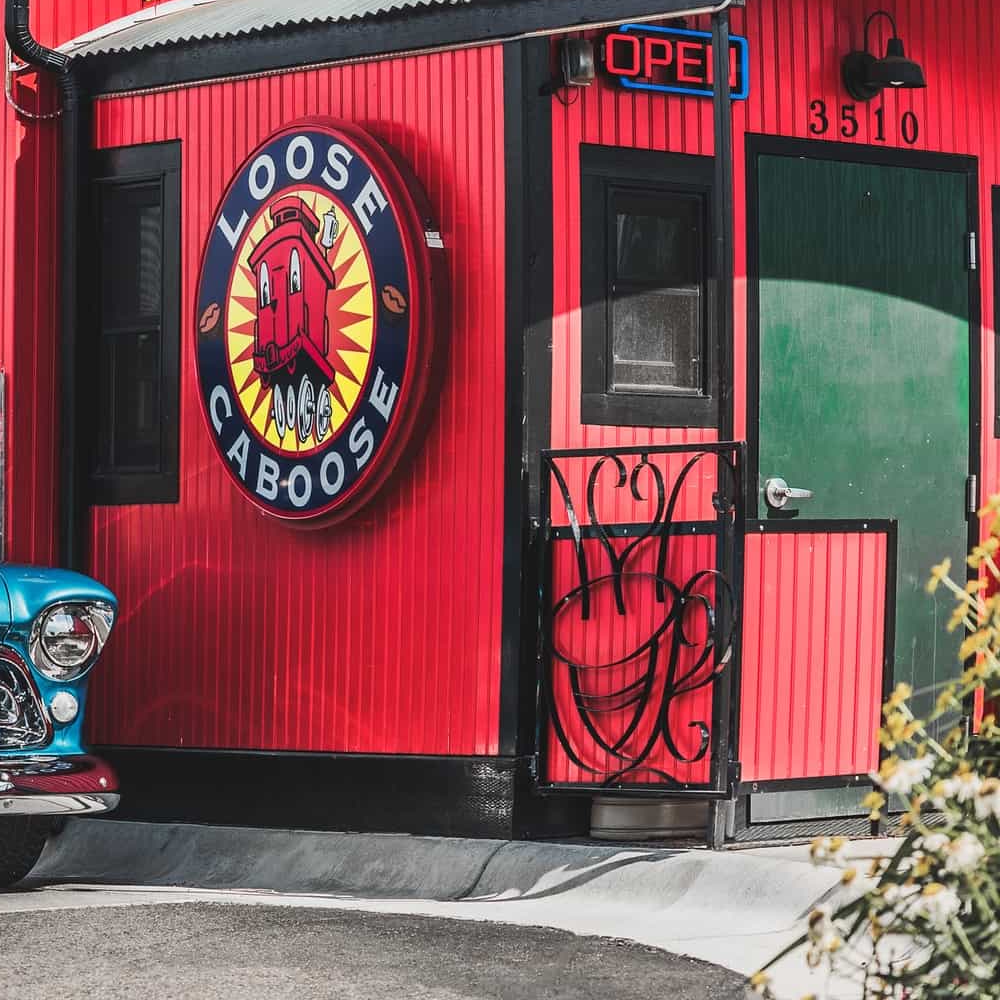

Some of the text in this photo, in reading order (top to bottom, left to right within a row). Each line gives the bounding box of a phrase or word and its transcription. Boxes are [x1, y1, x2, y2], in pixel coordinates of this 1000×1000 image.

[809, 100, 918, 144] 3510
[218, 136, 388, 249] LOOSE
[210, 366, 399, 507] CABOOSE
